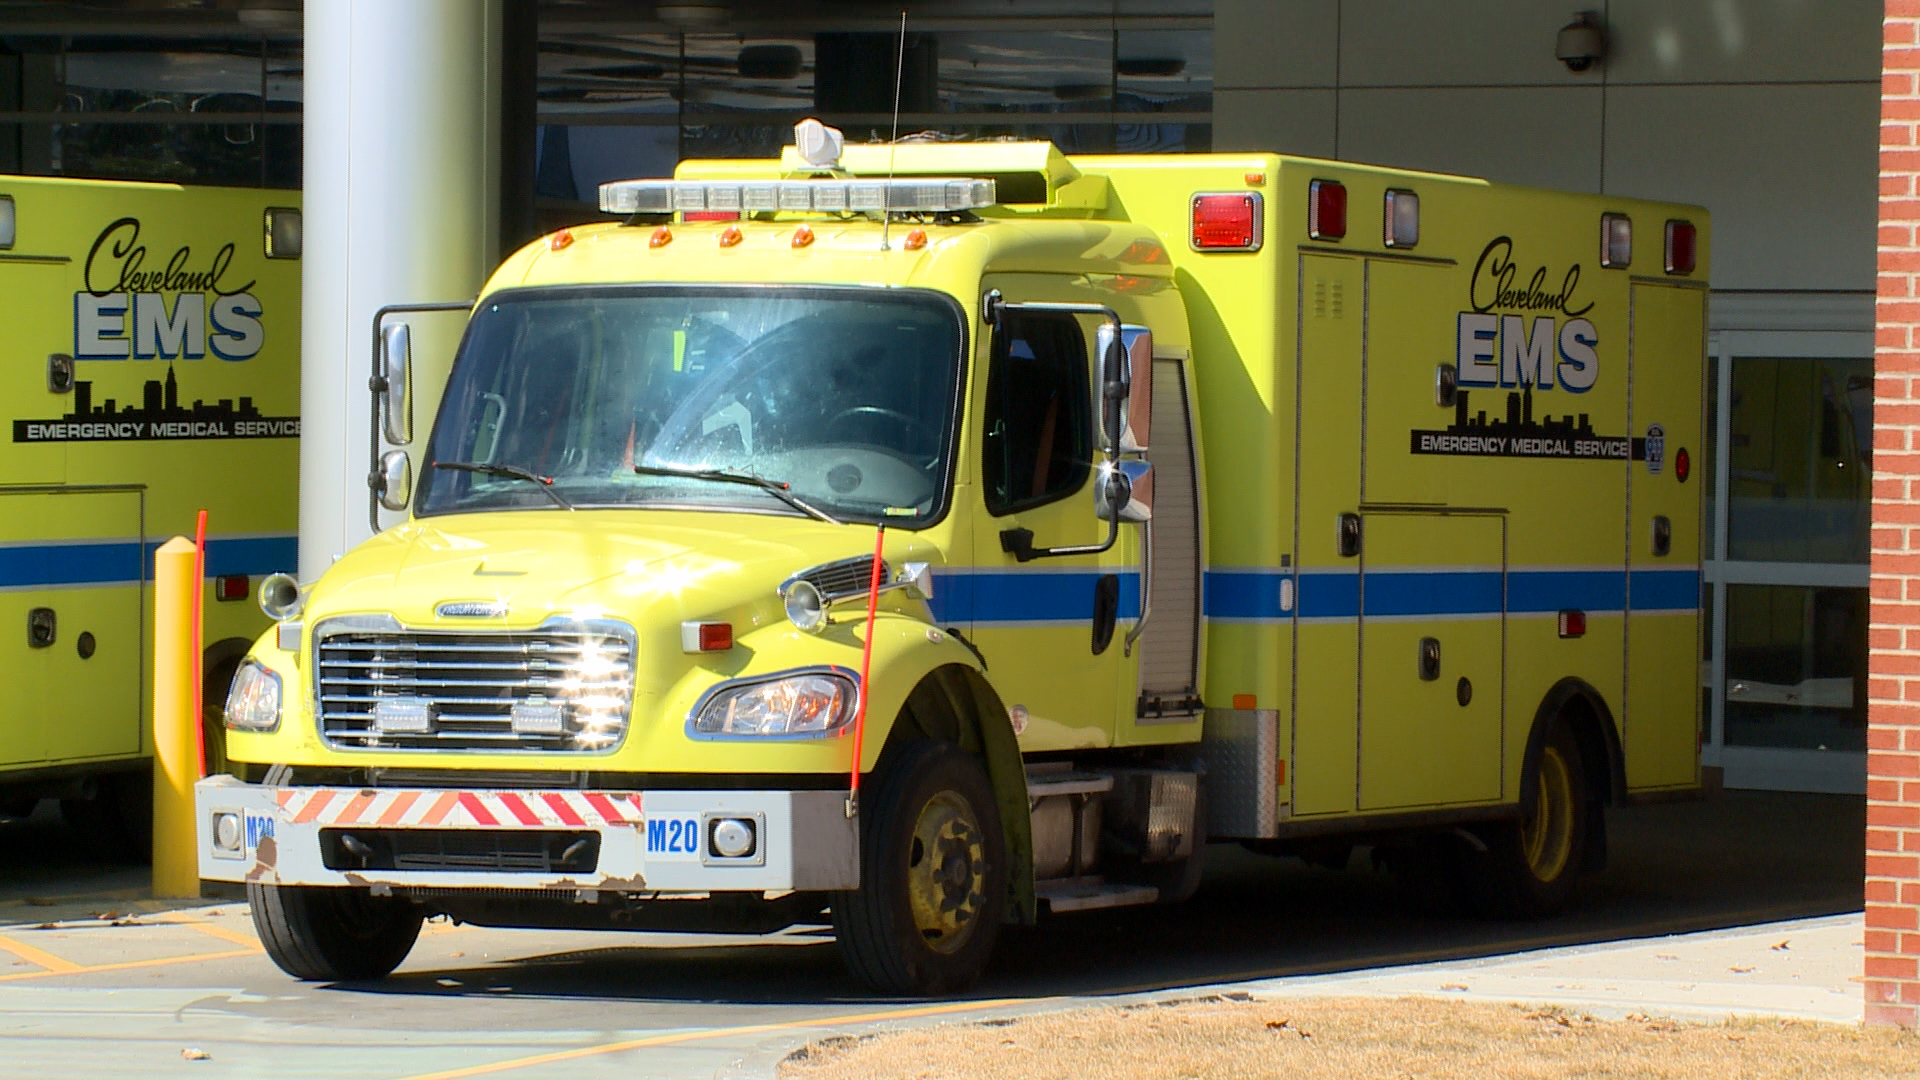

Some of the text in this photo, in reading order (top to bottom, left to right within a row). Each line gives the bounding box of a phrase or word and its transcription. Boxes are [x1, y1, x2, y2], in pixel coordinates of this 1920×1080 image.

[84, 217, 256, 297] Cleveland
[1471, 235, 1595, 317] Cleveland
[73, 291, 264, 361] EMS
[1457, 311, 1599, 393] EMS
[27, 422, 144, 439] EMERGENCY
[150, 421, 229, 437] MEDICAL
[1420, 434, 1628, 457] EMERGENCY MEDICAL SERVICE
[647, 819, 698, 853] M20
